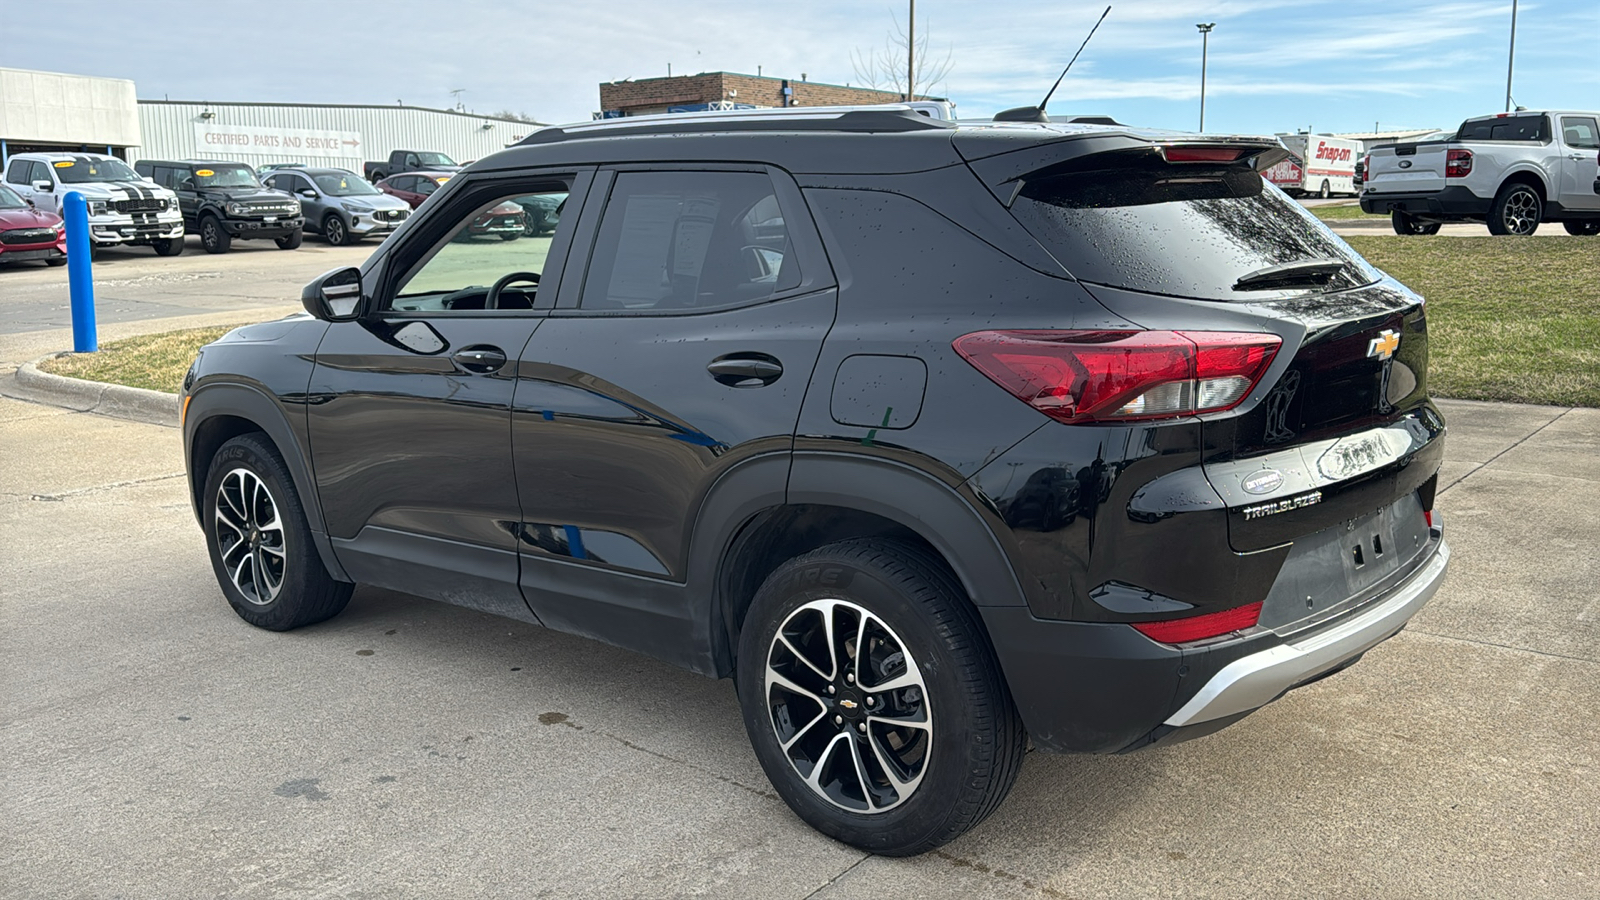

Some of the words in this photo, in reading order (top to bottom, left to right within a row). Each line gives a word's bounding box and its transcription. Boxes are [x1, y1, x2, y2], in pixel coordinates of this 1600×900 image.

[204, 132, 249, 146] CERTIFIED
[254, 134, 280, 147] PARTS
[282, 136, 302, 148] AND
[305, 137, 339, 150] SERVICE
[1316, 141, 1351, 164] Snap-on
[1275, 169, 1299, 181] SERVICE
[1243, 491, 1322, 521] TRAILBLAZER
